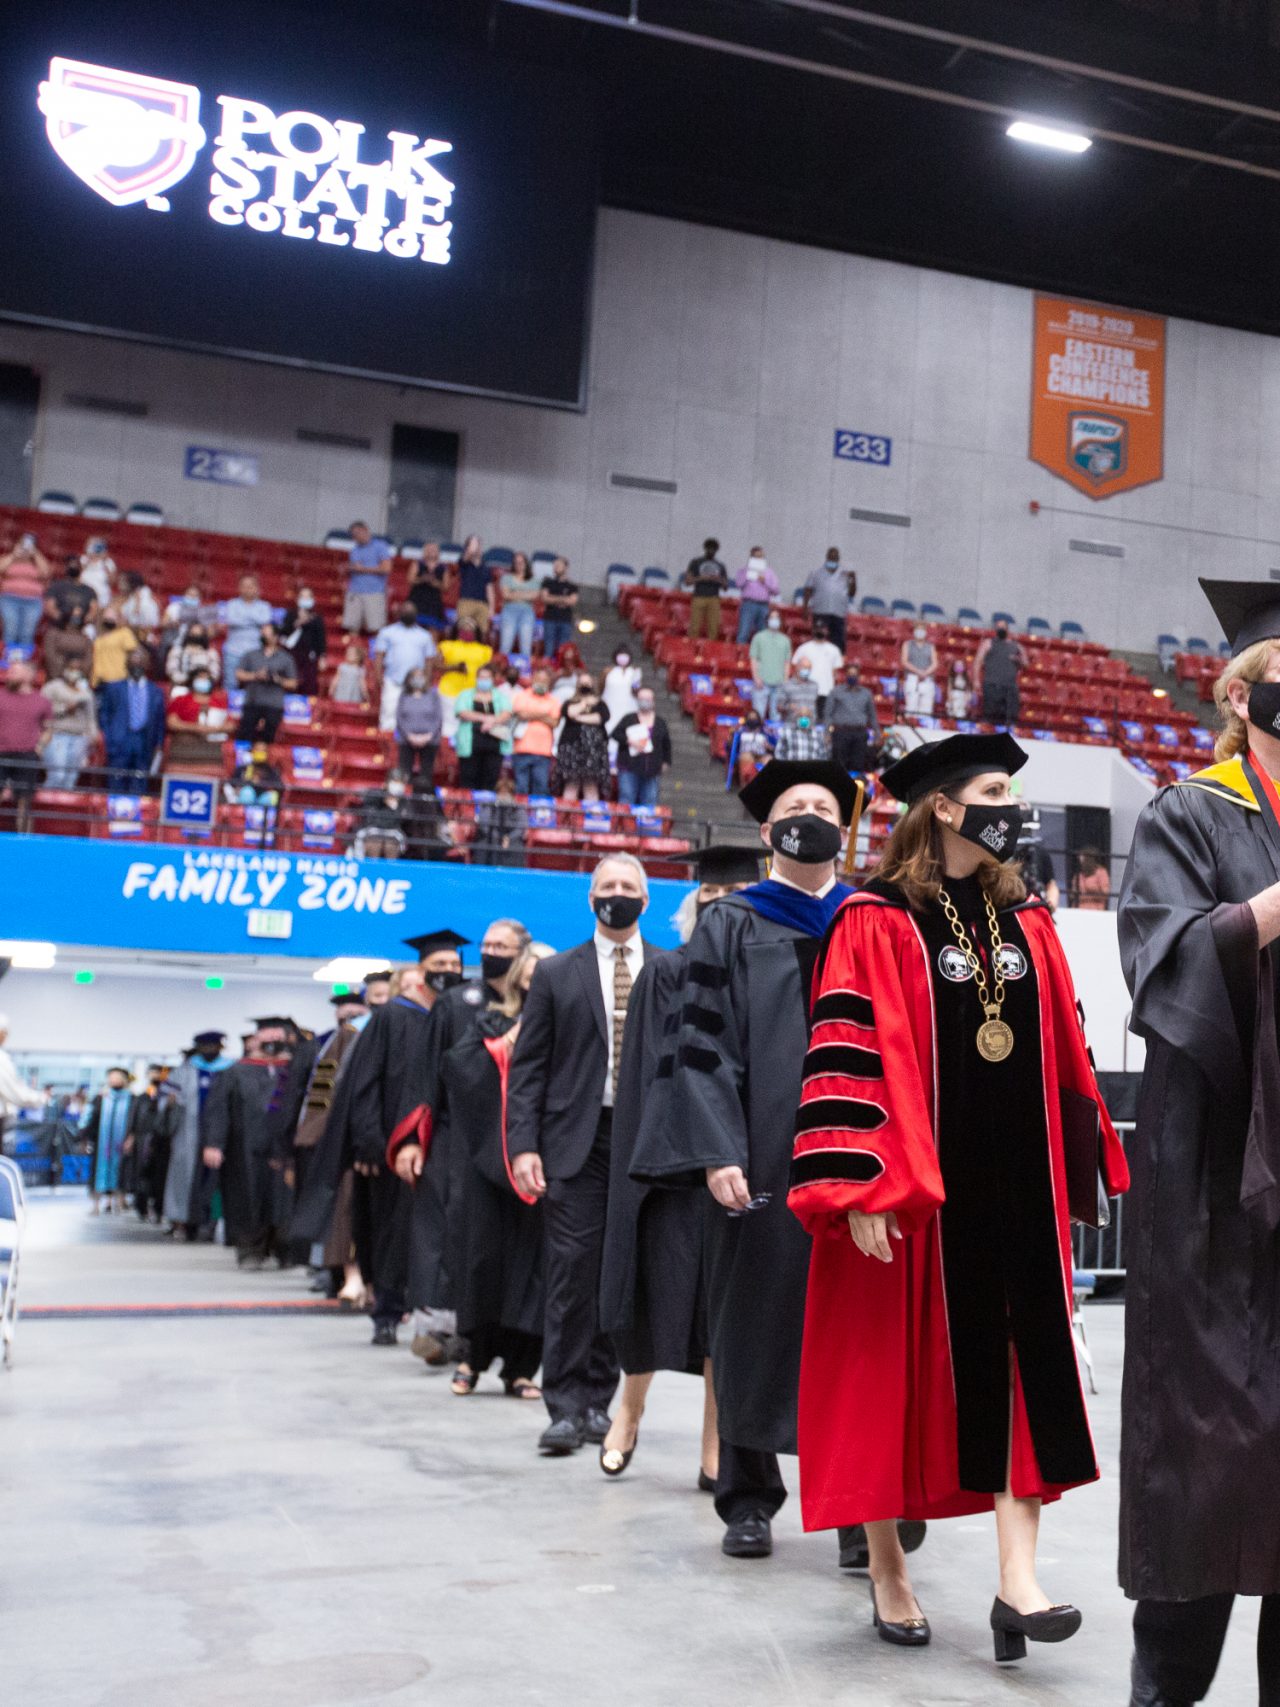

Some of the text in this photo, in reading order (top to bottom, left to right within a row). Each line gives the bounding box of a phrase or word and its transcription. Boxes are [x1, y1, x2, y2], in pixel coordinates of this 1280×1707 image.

[214, 94, 455, 193] POLK
[210, 145, 453, 236] STATE
[208, 194, 451, 265] COLLEGE
[1049, 353, 1149, 387] CONFERENCE
[1066, 338, 1135, 366] EASTERN
[1047, 370, 1150, 408] CHAMPIONS
[838, 433, 887, 462] 233
[170, 789, 208, 816] 32
[183, 851, 360, 879] LAKELAND MAGIC
[122, 861, 412, 915] FAMILY ZONE
